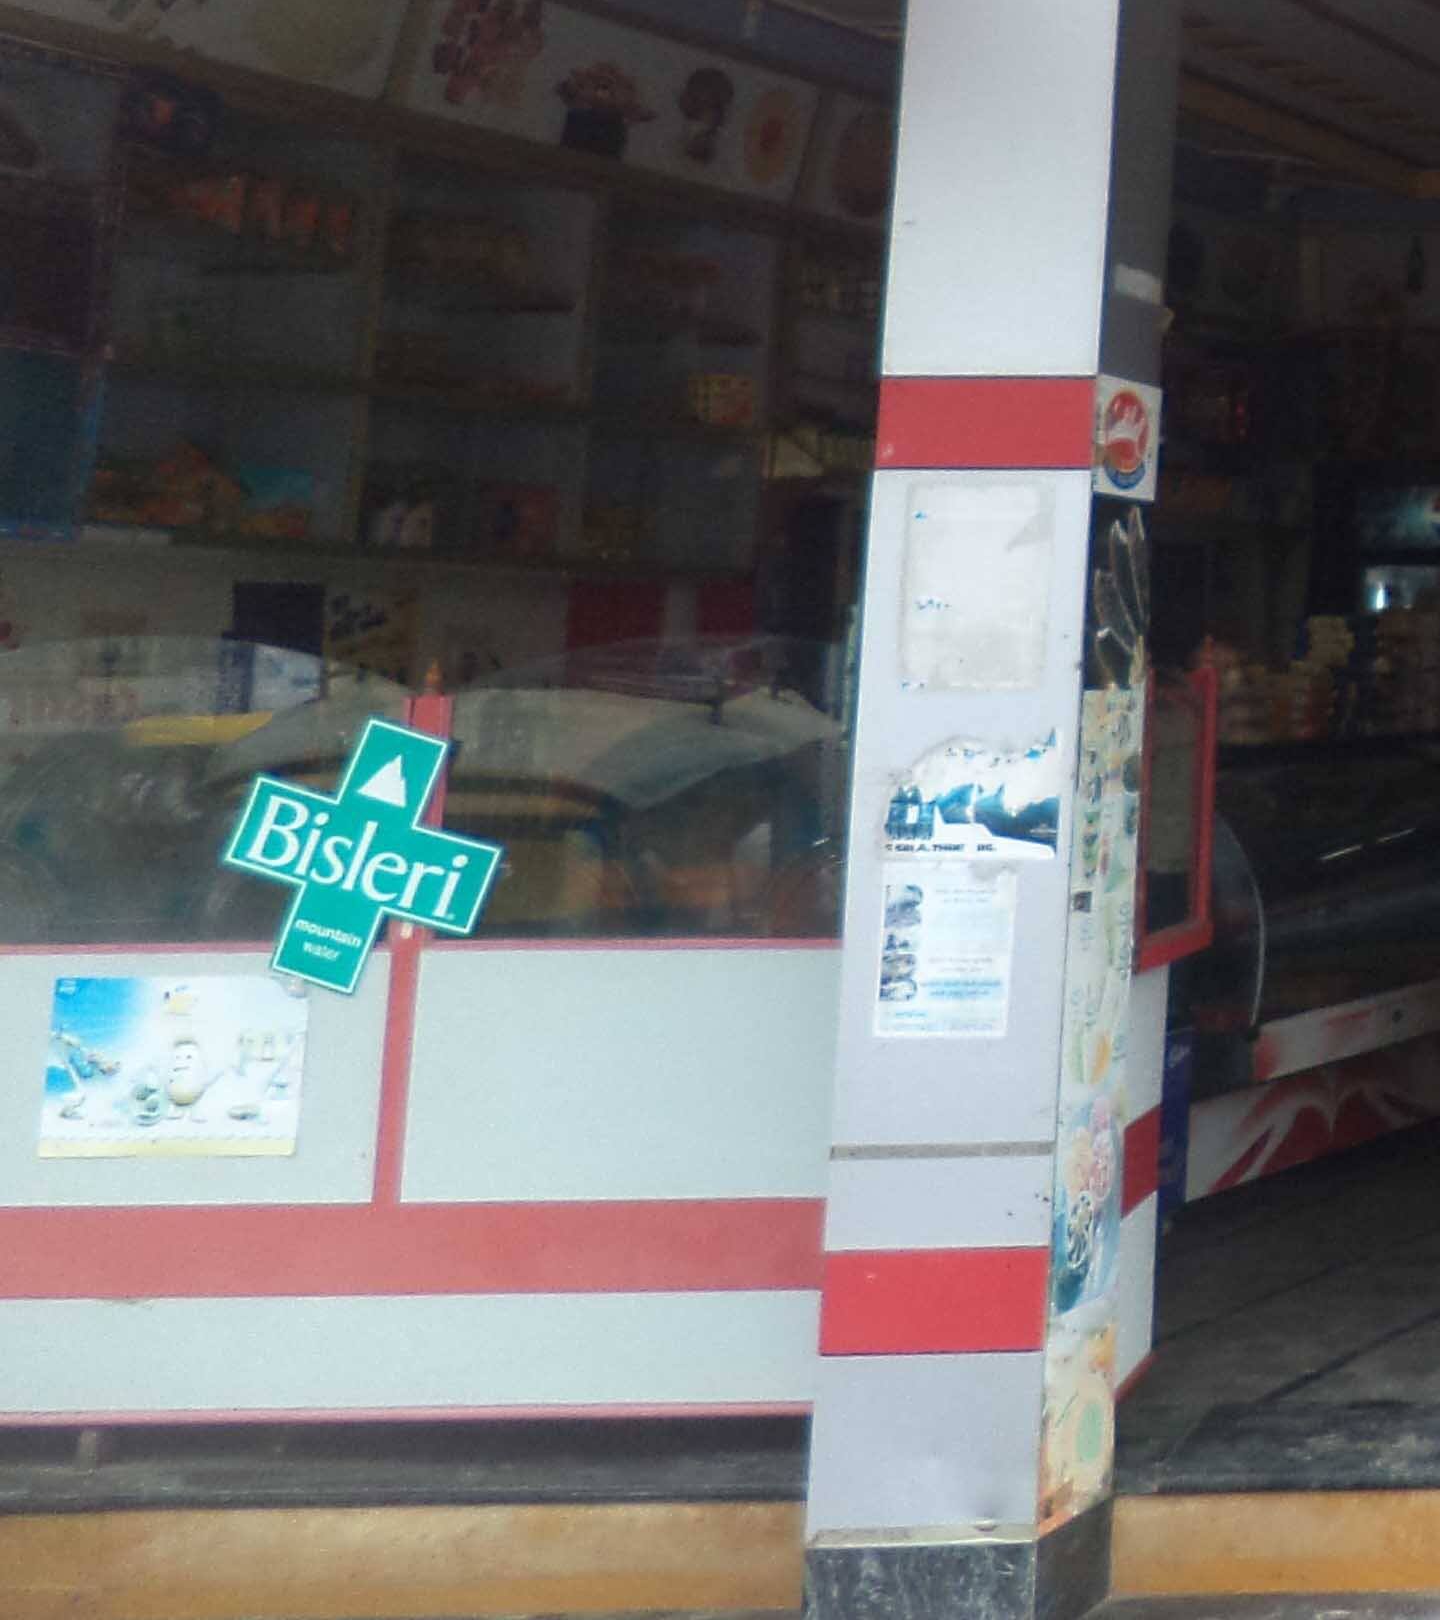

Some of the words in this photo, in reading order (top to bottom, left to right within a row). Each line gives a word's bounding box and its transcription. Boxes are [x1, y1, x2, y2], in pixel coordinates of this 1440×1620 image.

[245, 795, 470, 920] Bisleri
[295, 918, 362, 949] mountain
[303, 941, 341, 961] water
